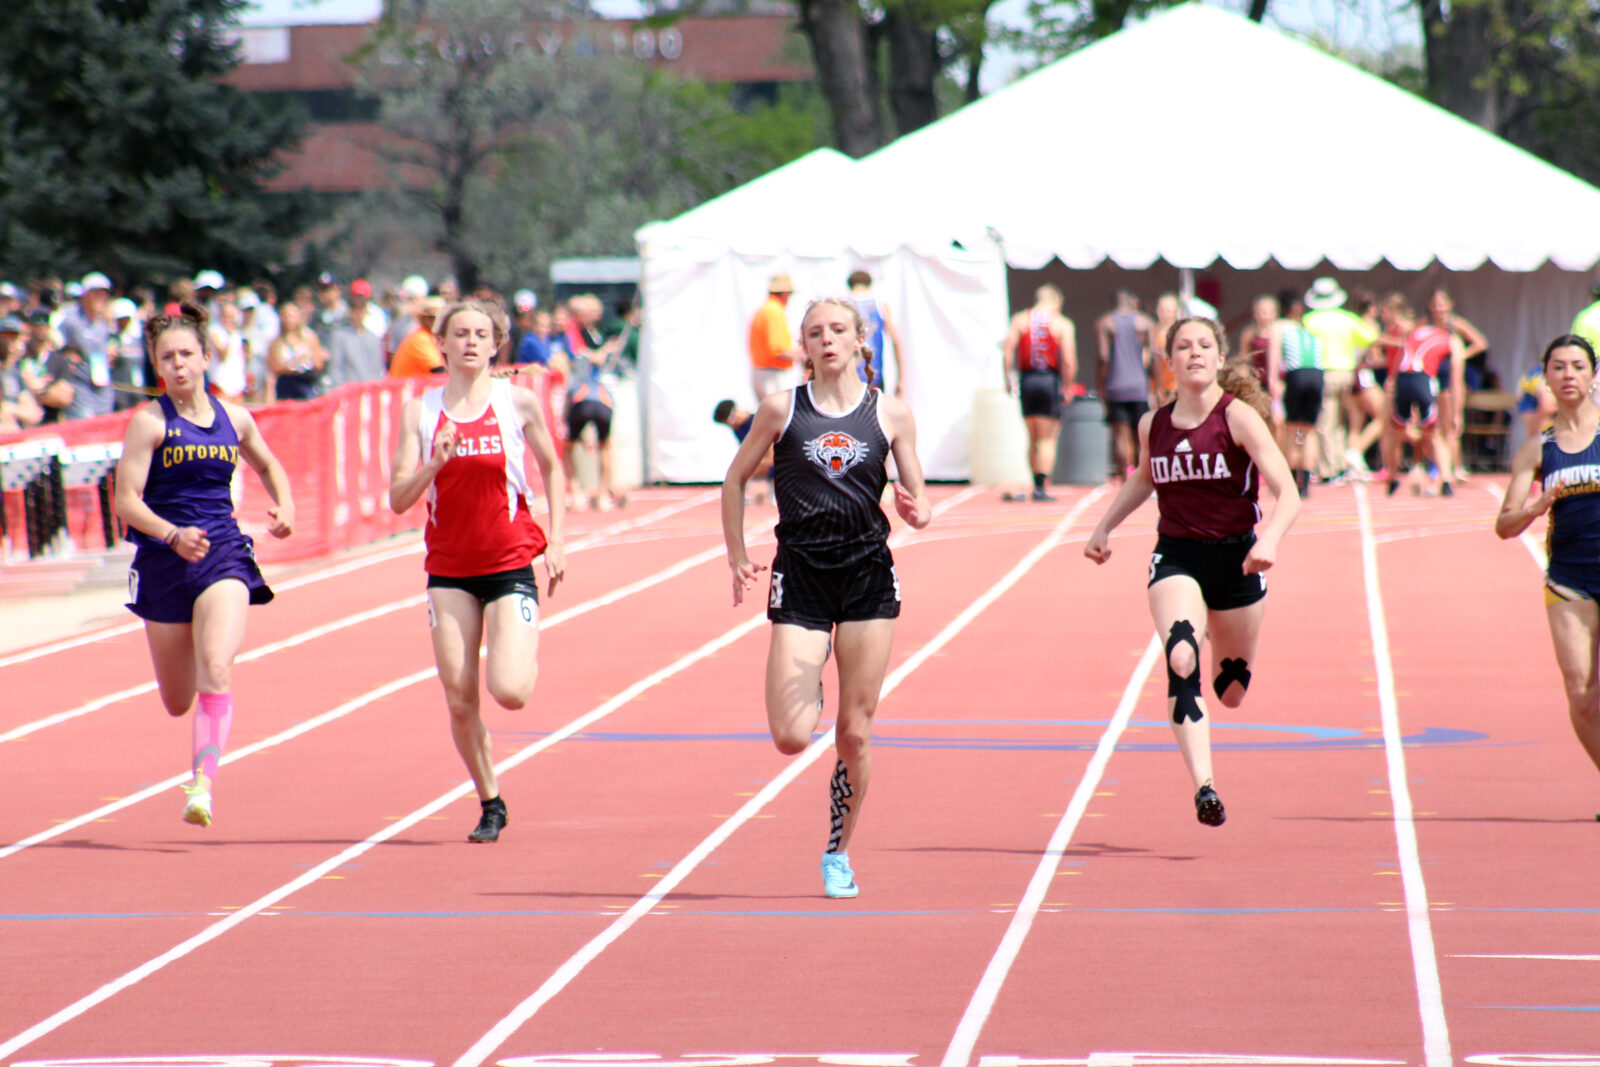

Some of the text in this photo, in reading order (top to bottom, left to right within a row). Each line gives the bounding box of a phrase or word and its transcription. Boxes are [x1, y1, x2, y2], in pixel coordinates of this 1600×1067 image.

[162, 444, 239, 469] COTOPAX
[455, 435, 502, 457] GLES
[1150, 452, 1232, 484] IDALIA
[1544, 464, 1600, 488] HANOVE
[520, 596, 532, 623] 6
